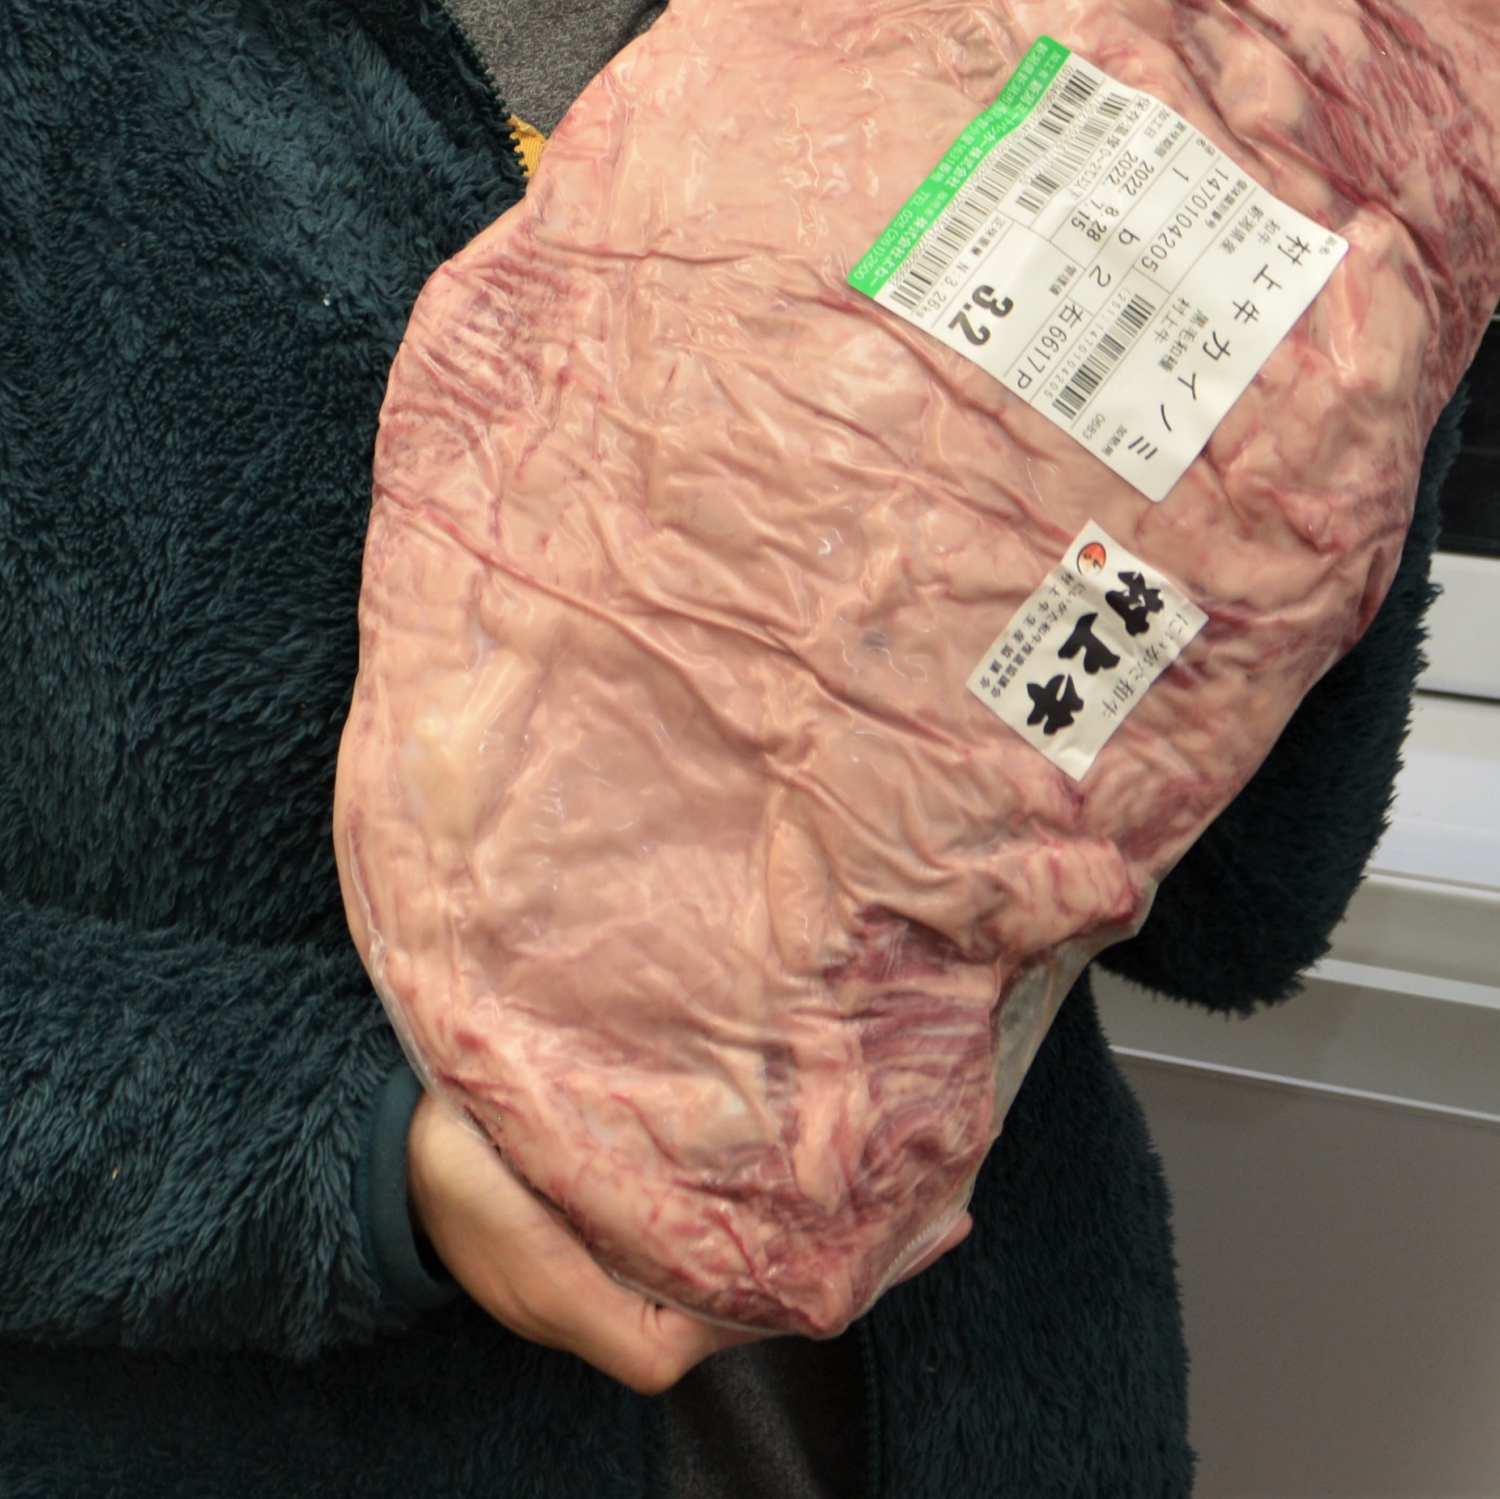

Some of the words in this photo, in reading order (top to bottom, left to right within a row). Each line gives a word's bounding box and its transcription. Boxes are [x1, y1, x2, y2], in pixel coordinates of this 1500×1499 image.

[1143, 109, 1170, 138] 加工日
[1154, 120, 1186, 158] 賞味期限
[1171, 166, 1189, 182] 1
[907, 189, 931, 207] TEL
[1140, 168, 1228, 272] 1470104205
[1204, 179, 1247, 229] 個体識別番号
[1117, 227, 1140, 245] b
[1220, 204, 1264, 254] 新潟県産
[1257, 218, 1280, 243] 和牛
[1088, 264, 1111, 287] 2
[948, 284, 1013, 346] 3.2
[1154, 297, 1190, 342] 村上牛
[1127, 235, 1310, 460] 村上牛カイノミ
[1158, 309, 1208, 371] 黒毛和種
[1081, 412, 1105, 440] 0683
[1026, 570, 1164, 735] 村上牛
[1102, 612, 1188, 717] にいがた和牛
